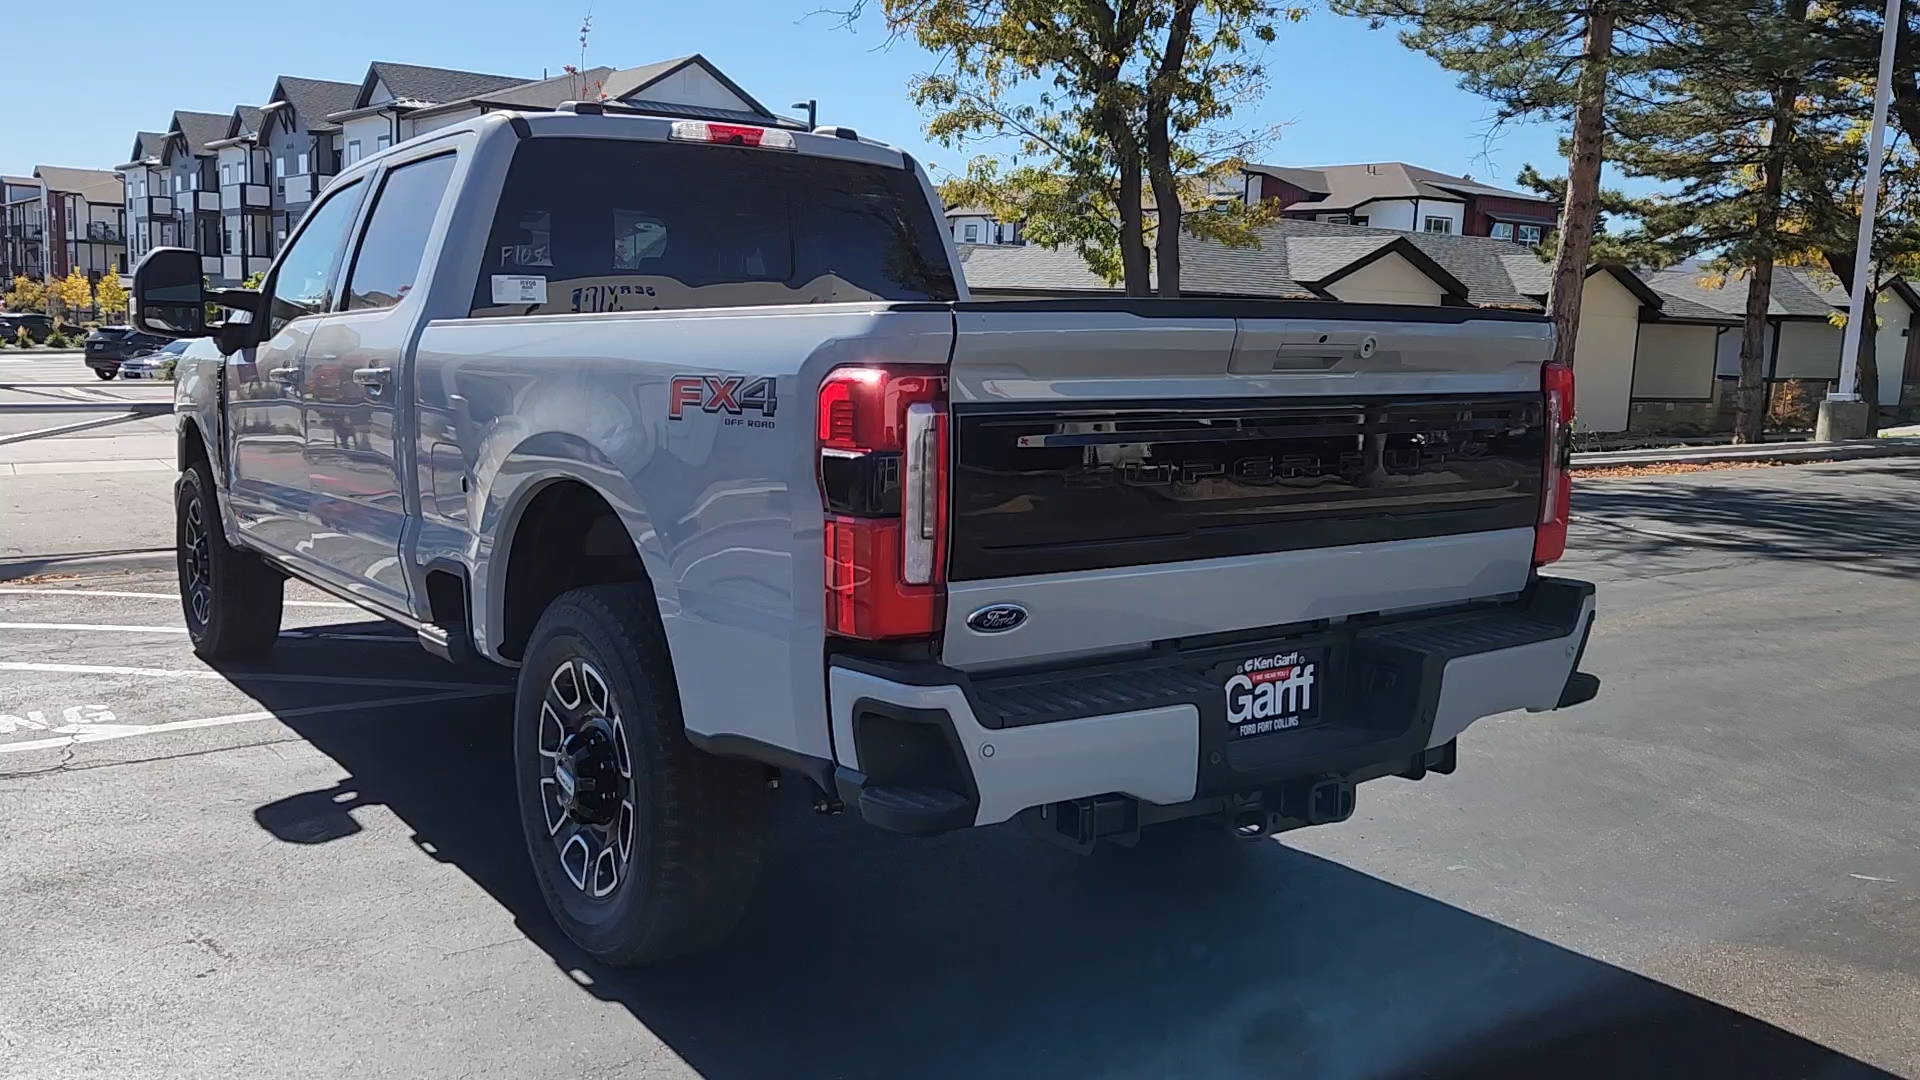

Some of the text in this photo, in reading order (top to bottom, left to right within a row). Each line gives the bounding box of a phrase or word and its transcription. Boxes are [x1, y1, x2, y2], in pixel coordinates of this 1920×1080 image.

[669, 375, 778, 421] FX4
[724, 418, 776, 429] OFF ROAD
[1254, 652, 1298, 671] Ken Garff
[1224, 664, 1314, 724] Garff
[1240, 716, 1299, 736] FORD FORT COLLINS
